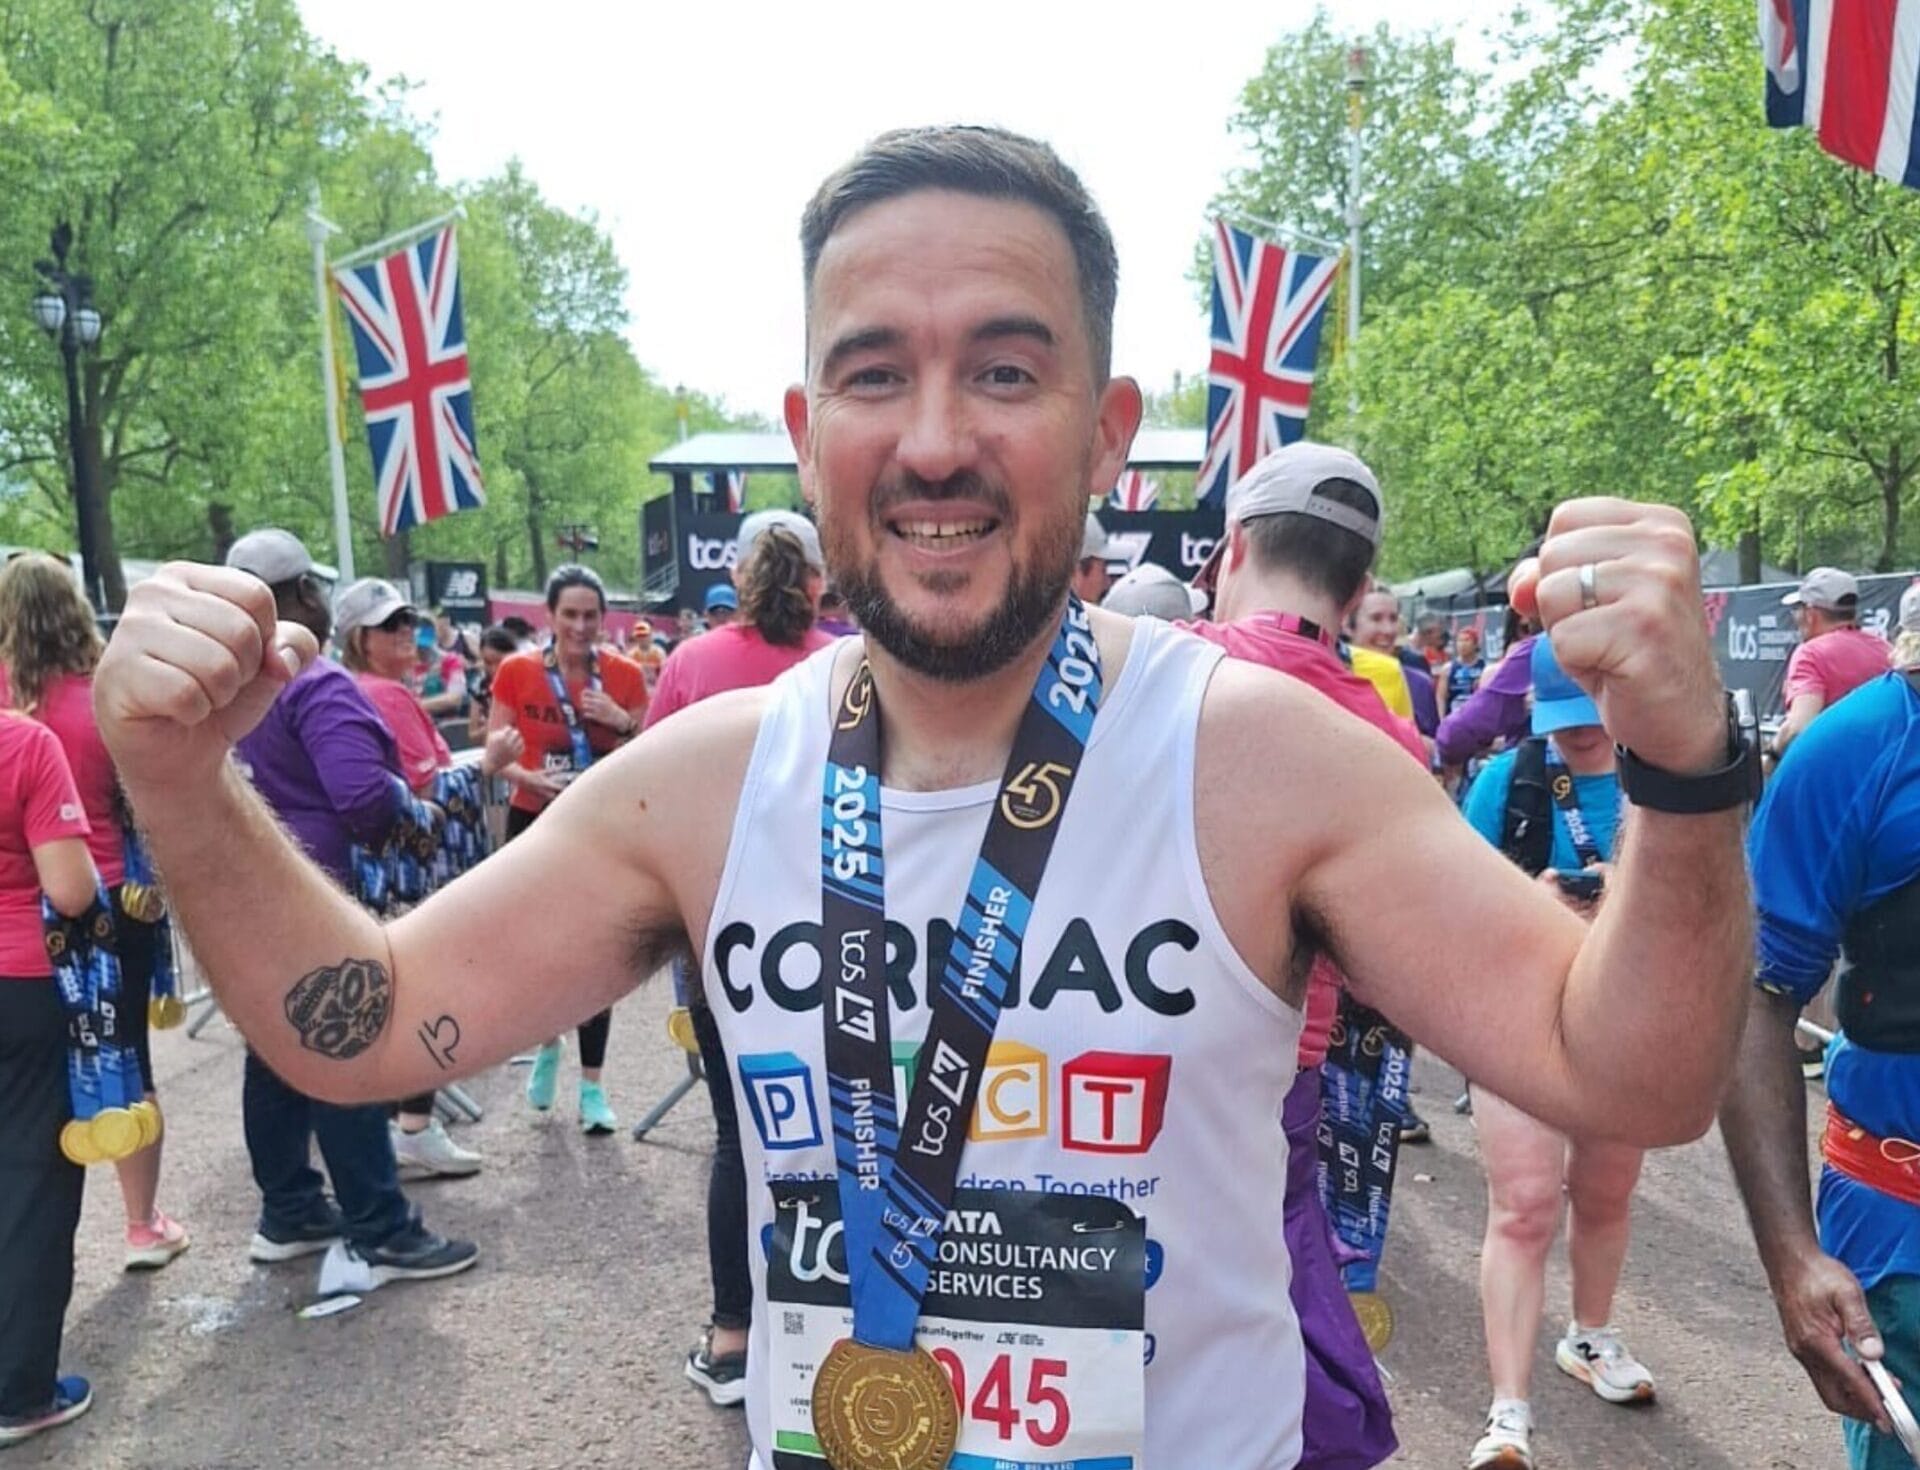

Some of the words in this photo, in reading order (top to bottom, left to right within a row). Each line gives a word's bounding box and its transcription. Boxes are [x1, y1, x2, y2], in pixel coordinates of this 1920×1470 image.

[1181, 531, 1214, 567] tc
[832, 765, 868, 881] 2025
[841, 929, 870, 982] tcs
[961, 886, 1012, 1000] FINISHER
[1382, 1047, 1405, 1100] 2025
[850, 1077, 880, 1191] FINISHER
[911, 1103, 952, 1156] tcs
[790, 1200, 850, 1284] tc
[944, 1210, 1003, 1235] ATA
[934, 1241, 1117, 1272] ONSULTANCY
[926, 1270, 1043, 1300] SERVICES
